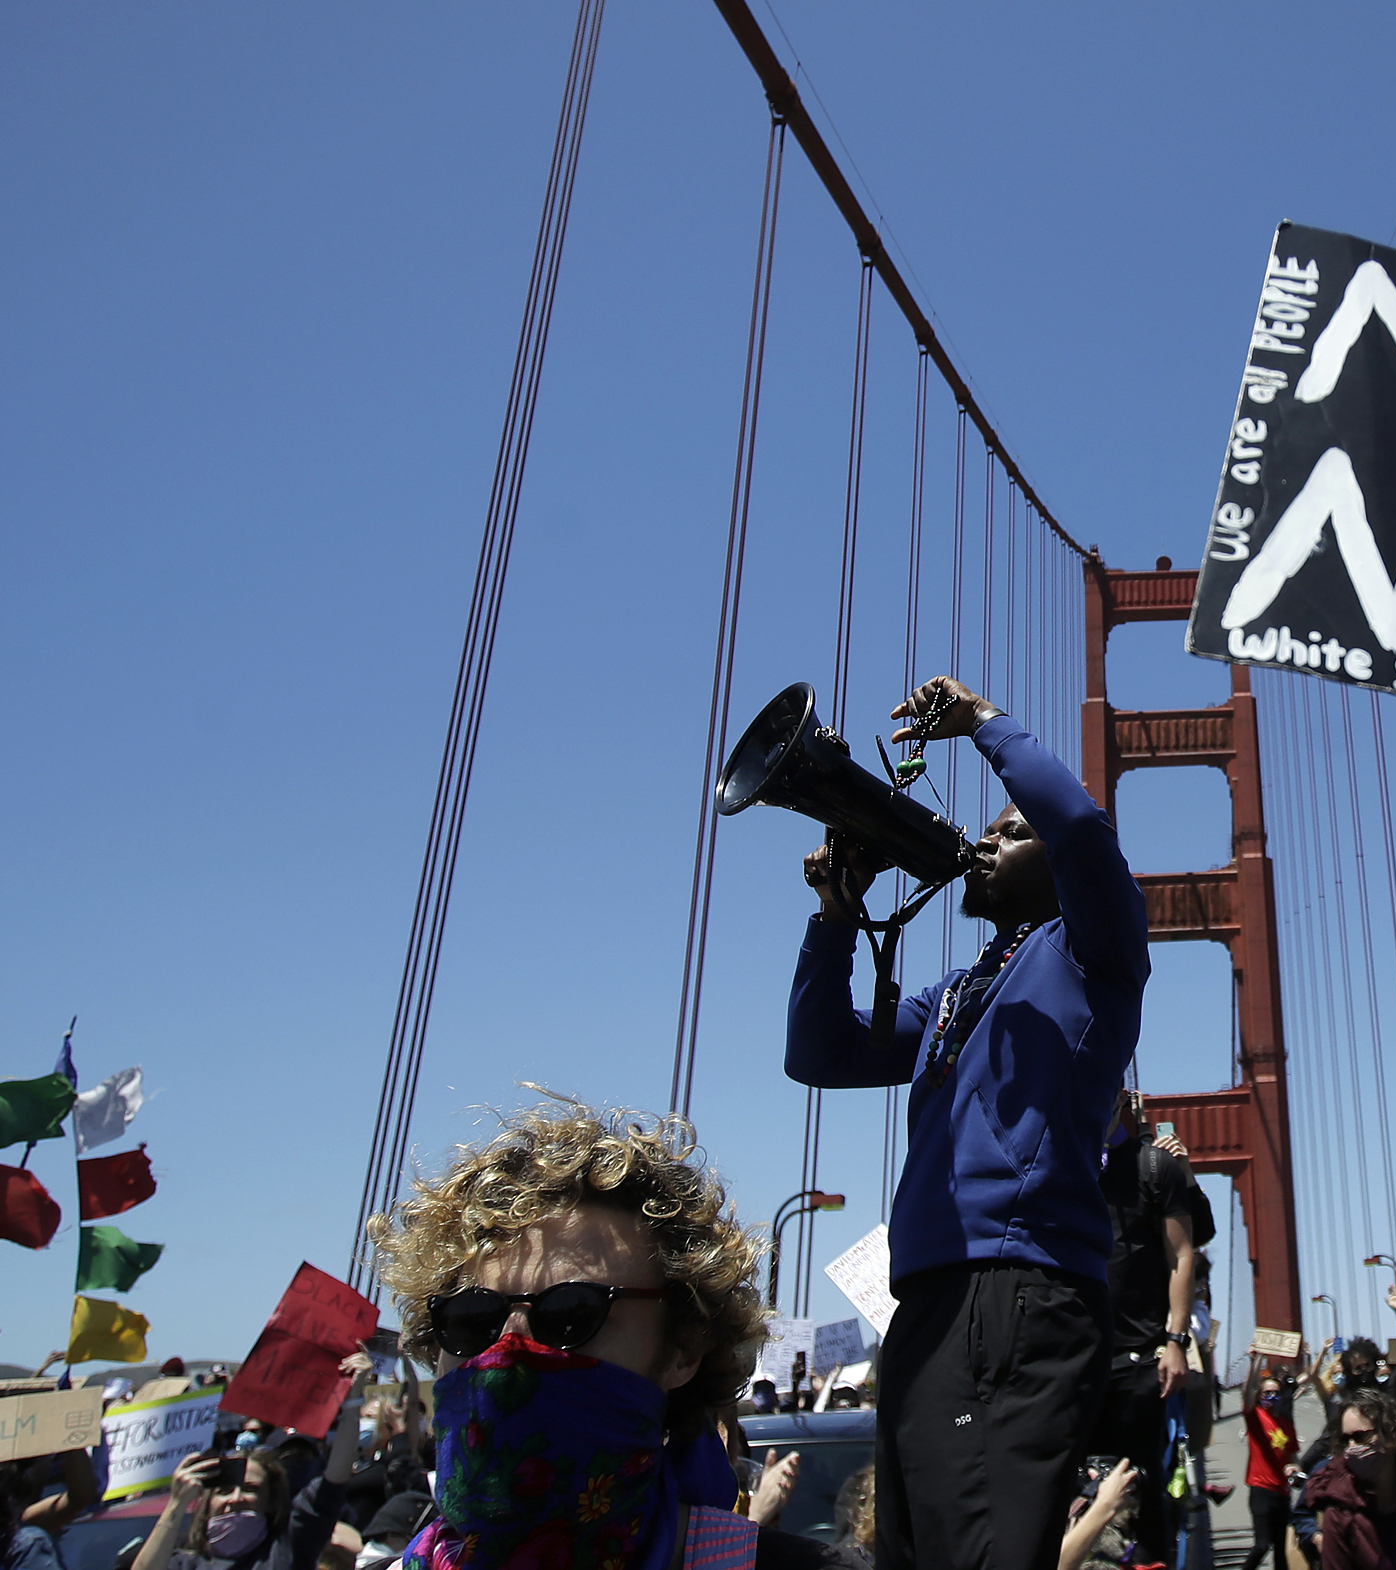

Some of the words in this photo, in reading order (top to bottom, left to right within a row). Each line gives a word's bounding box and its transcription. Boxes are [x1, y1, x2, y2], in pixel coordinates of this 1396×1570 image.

[1252, 254, 1320, 354] PEOPLE
[1243, 365, 1289, 404] all
[1230, 417, 1268, 485] are
[1228, 627, 1373, 679] White
[0, 1413, 36, 1440] LM
